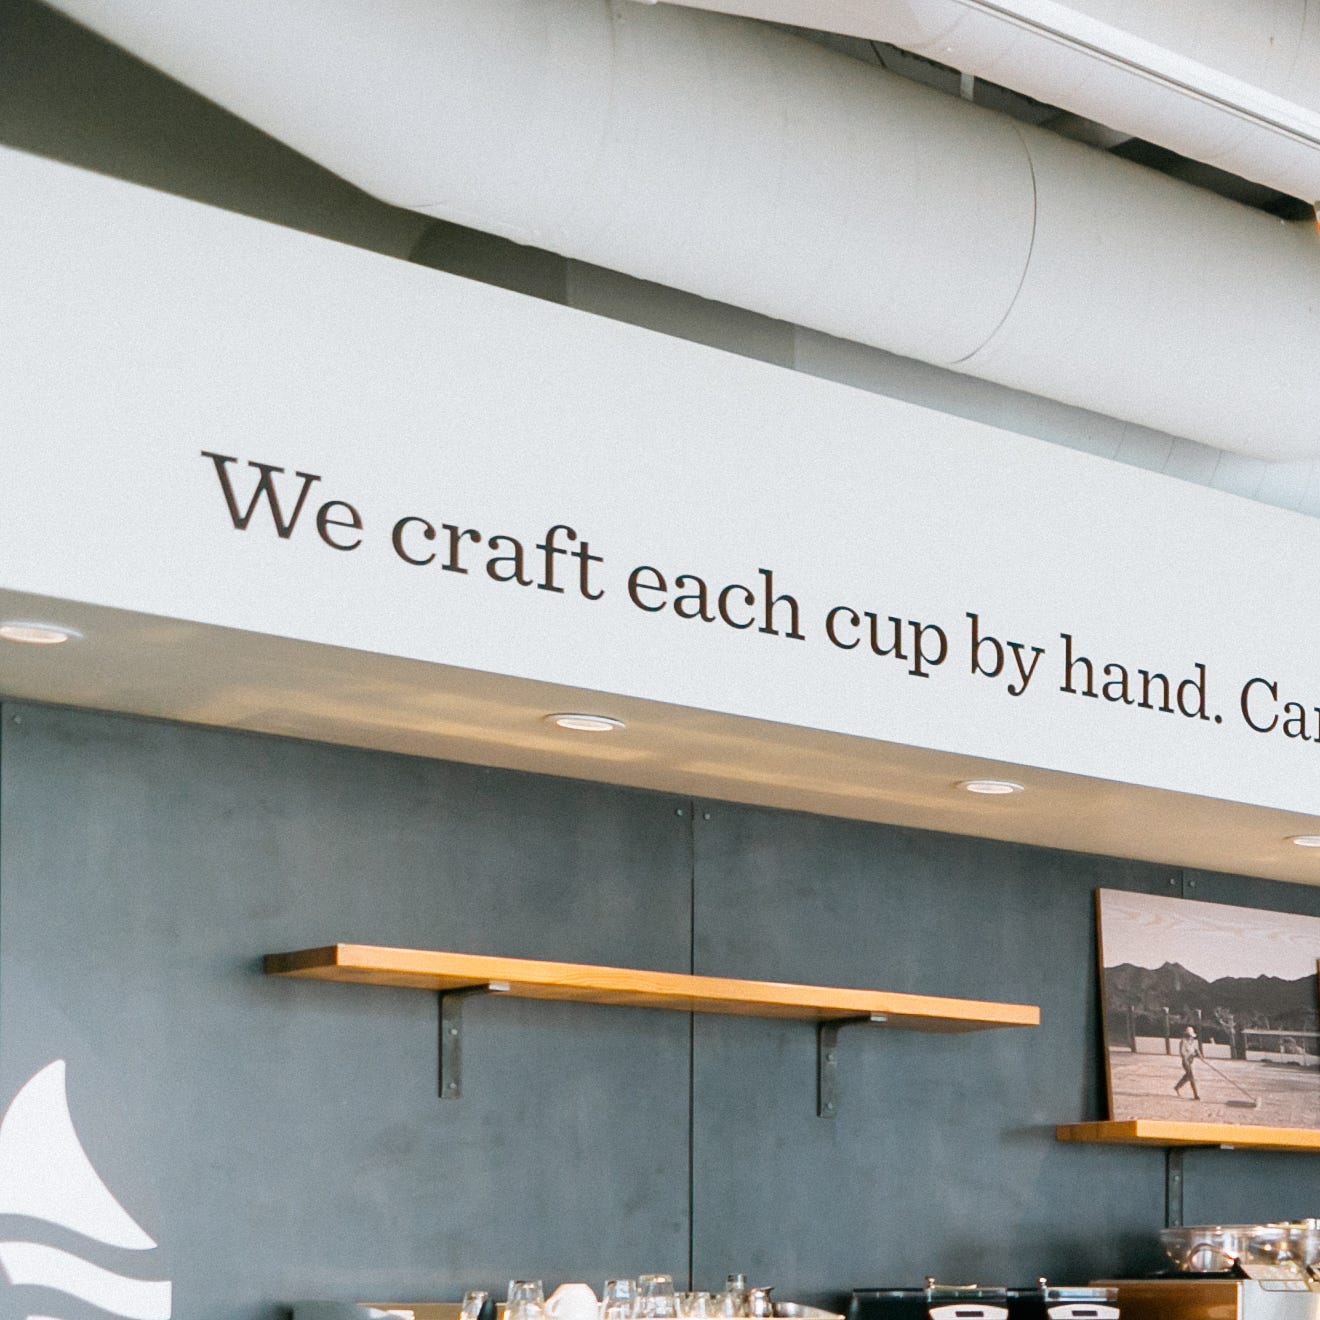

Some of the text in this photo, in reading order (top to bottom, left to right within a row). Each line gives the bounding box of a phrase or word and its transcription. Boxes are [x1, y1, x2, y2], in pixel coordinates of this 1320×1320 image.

[200, 450, 364, 552] We
[391, 515, 605, 601] craft
[627, 565, 806, 642] each
[825, 605, 949, 679] cup
[965, 611, 1046, 697] by
[1059, 632, 1223, 725] hand.
